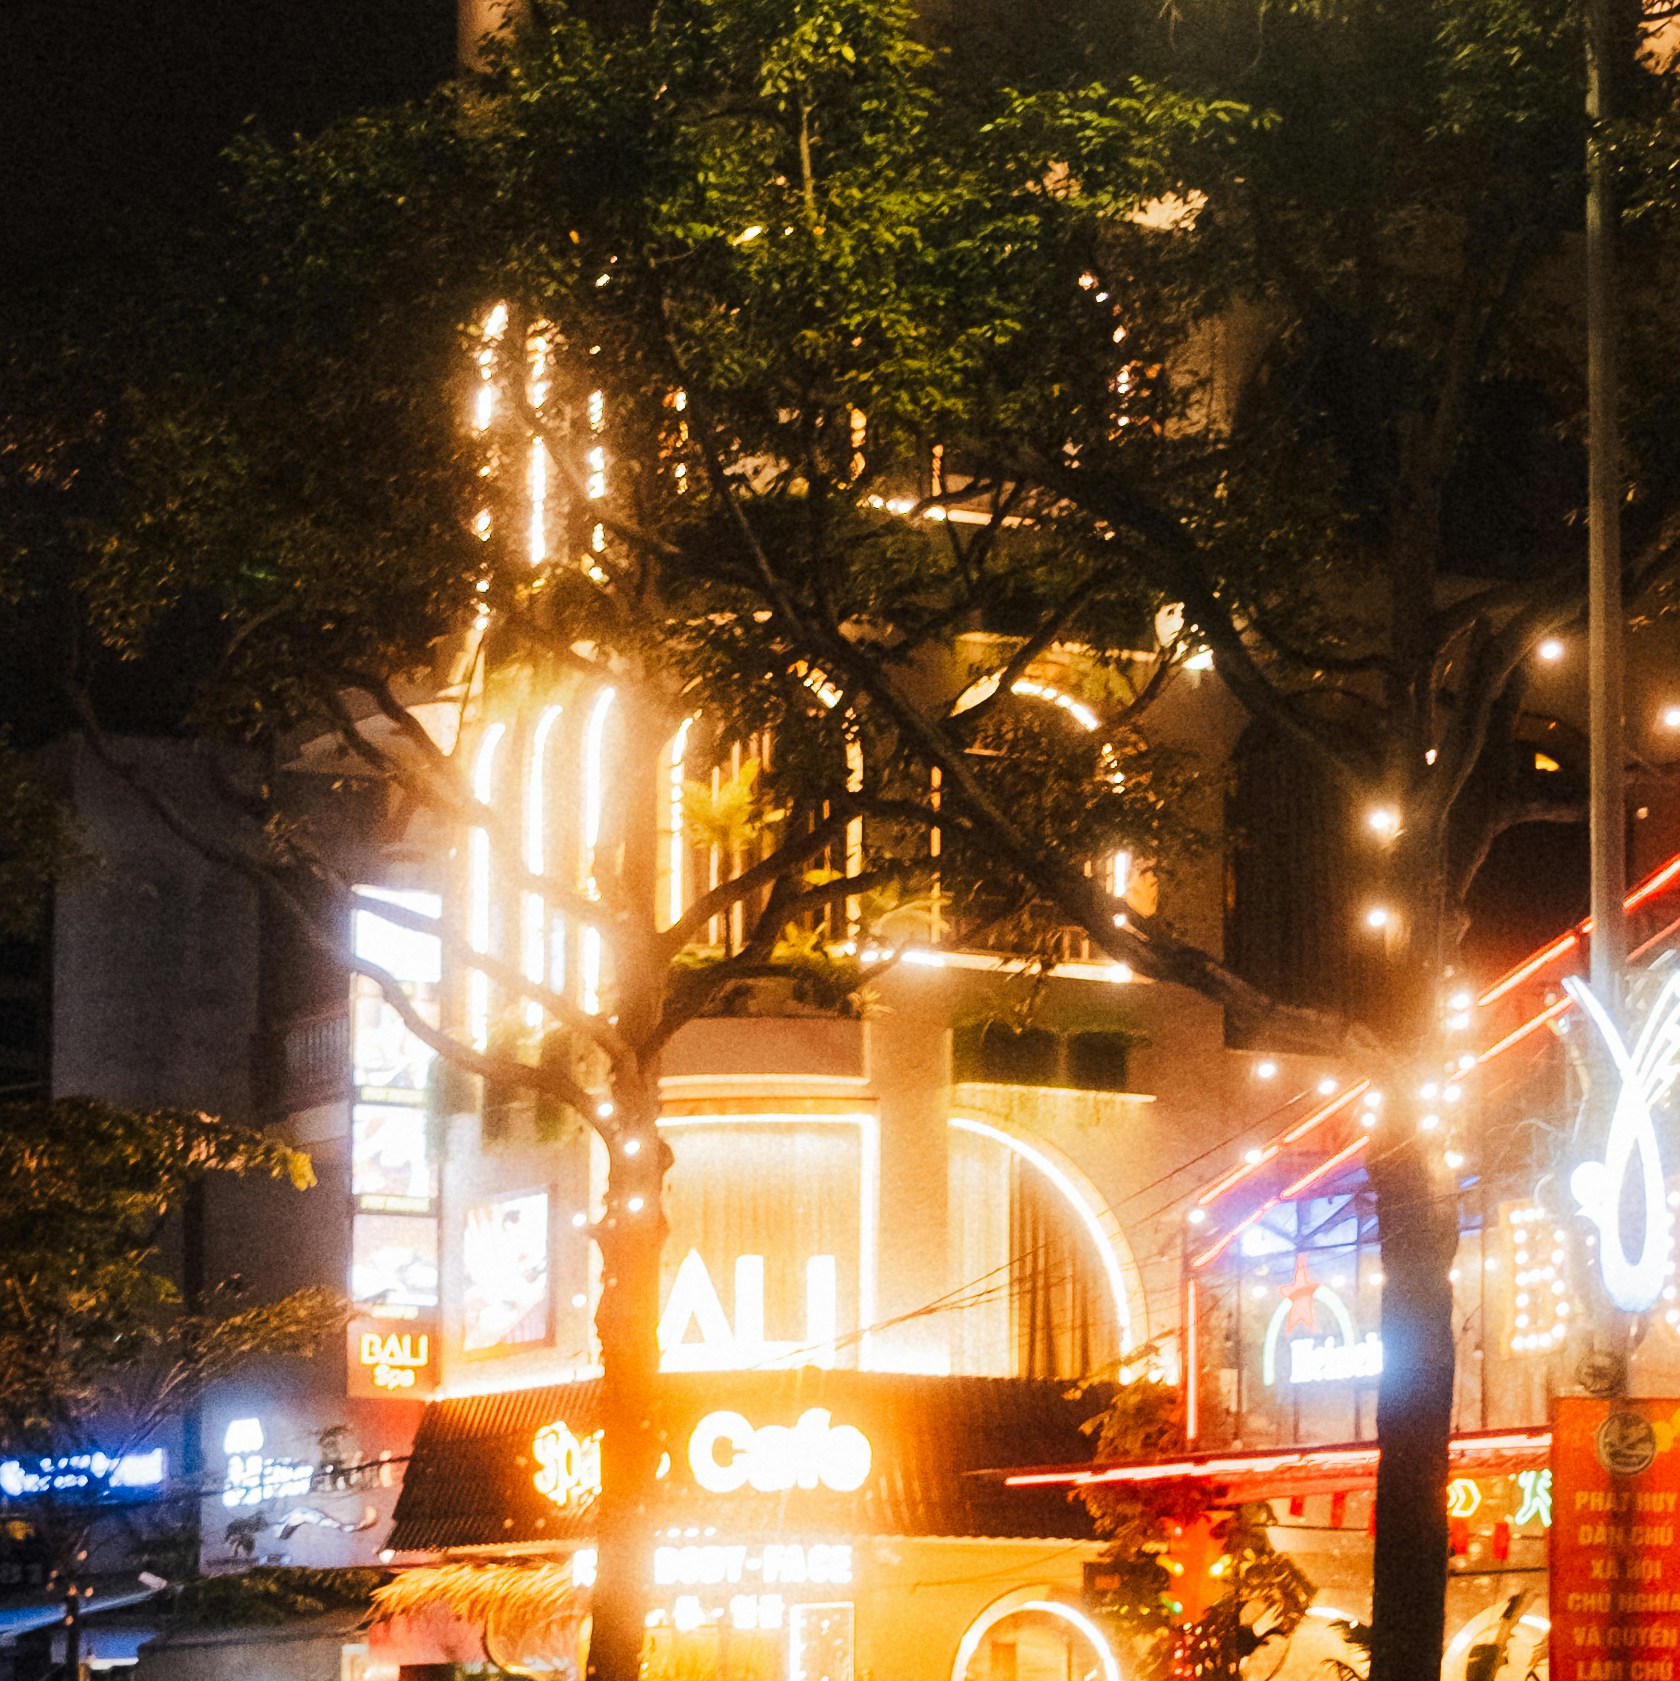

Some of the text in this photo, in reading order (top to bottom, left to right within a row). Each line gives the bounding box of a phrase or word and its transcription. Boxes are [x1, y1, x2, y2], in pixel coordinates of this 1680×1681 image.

[655, 1248, 837, 1373] ALI
[360, 1332, 429, 1367] BALI
[373, 1364, 416, 1391] Spa
[688, 1408, 872, 1492] Cafe
